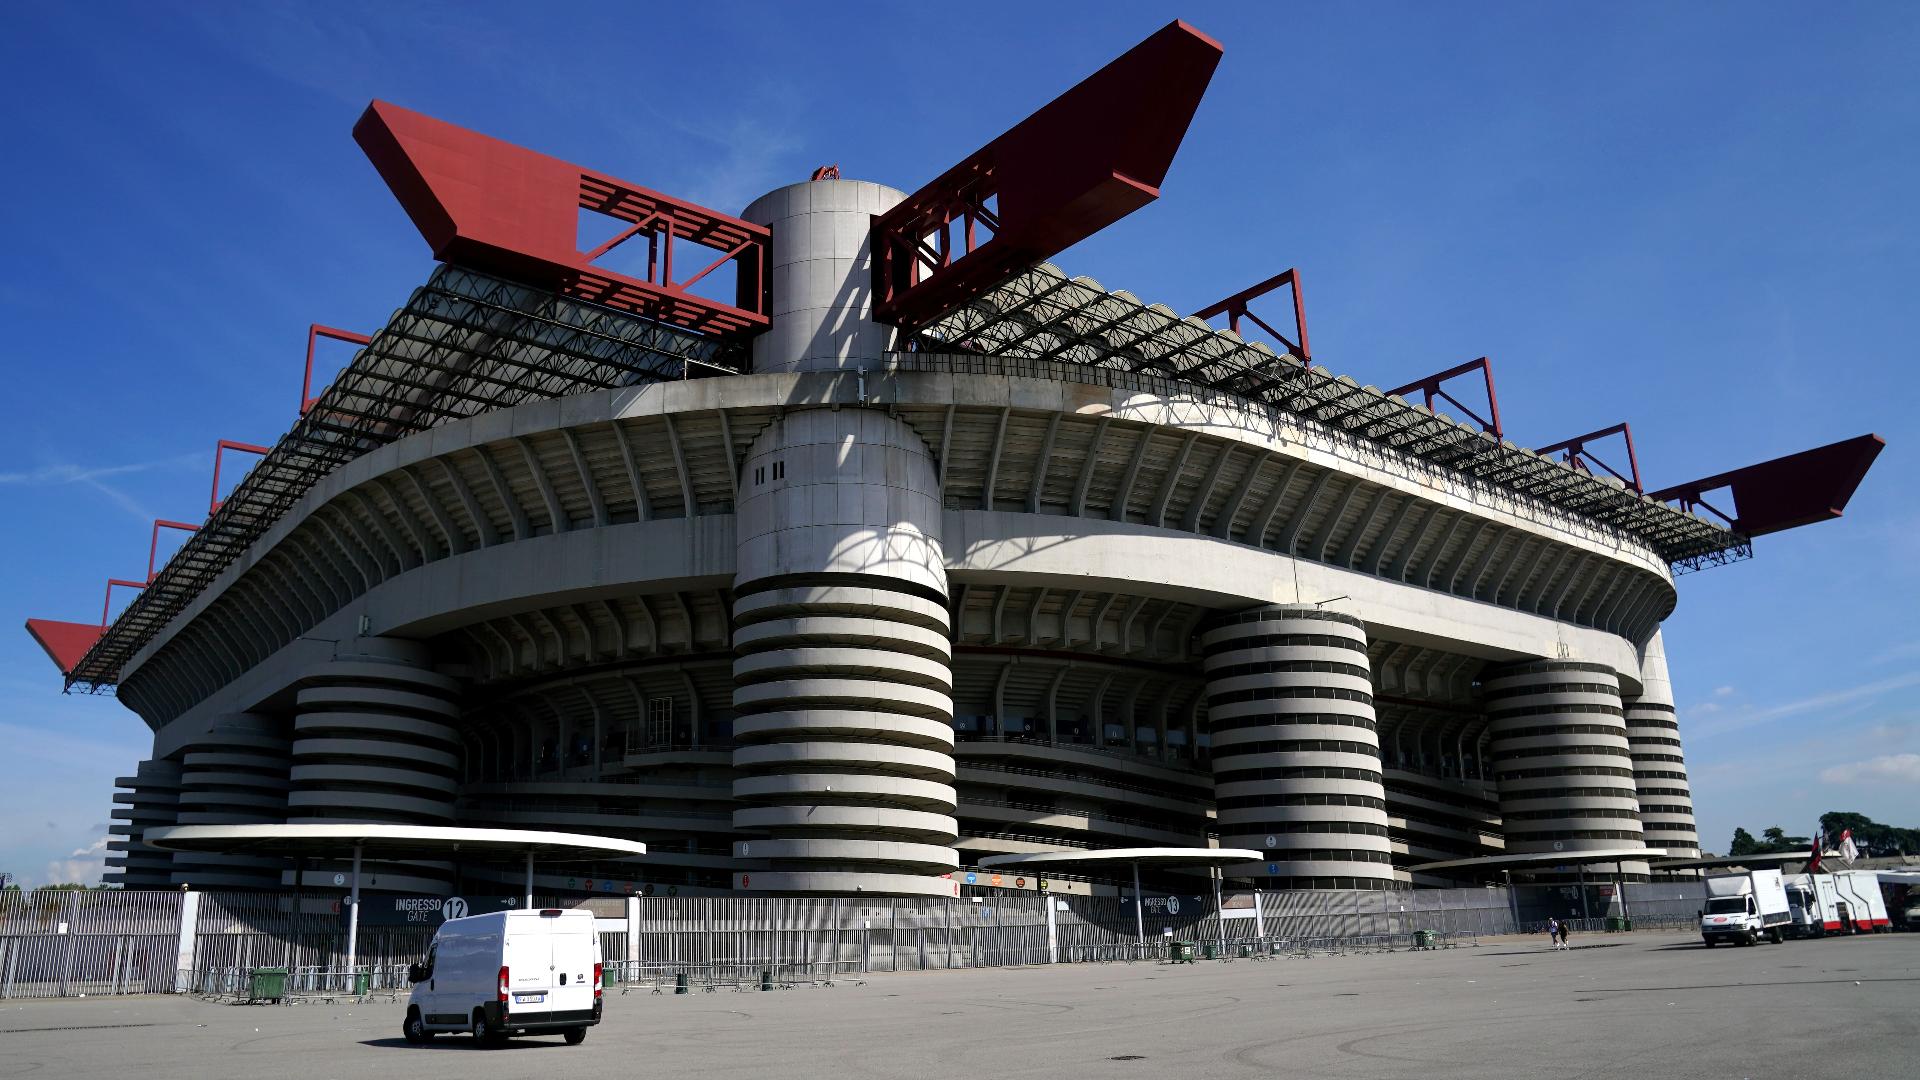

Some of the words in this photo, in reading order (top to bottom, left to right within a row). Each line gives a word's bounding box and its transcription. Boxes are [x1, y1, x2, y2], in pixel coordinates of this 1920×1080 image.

[395, 898, 441, 911] INGRESSO
[446, 899, 466, 919] 12
[1168, 898, 1178, 913] 13
[407, 910, 429, 922] GATE
